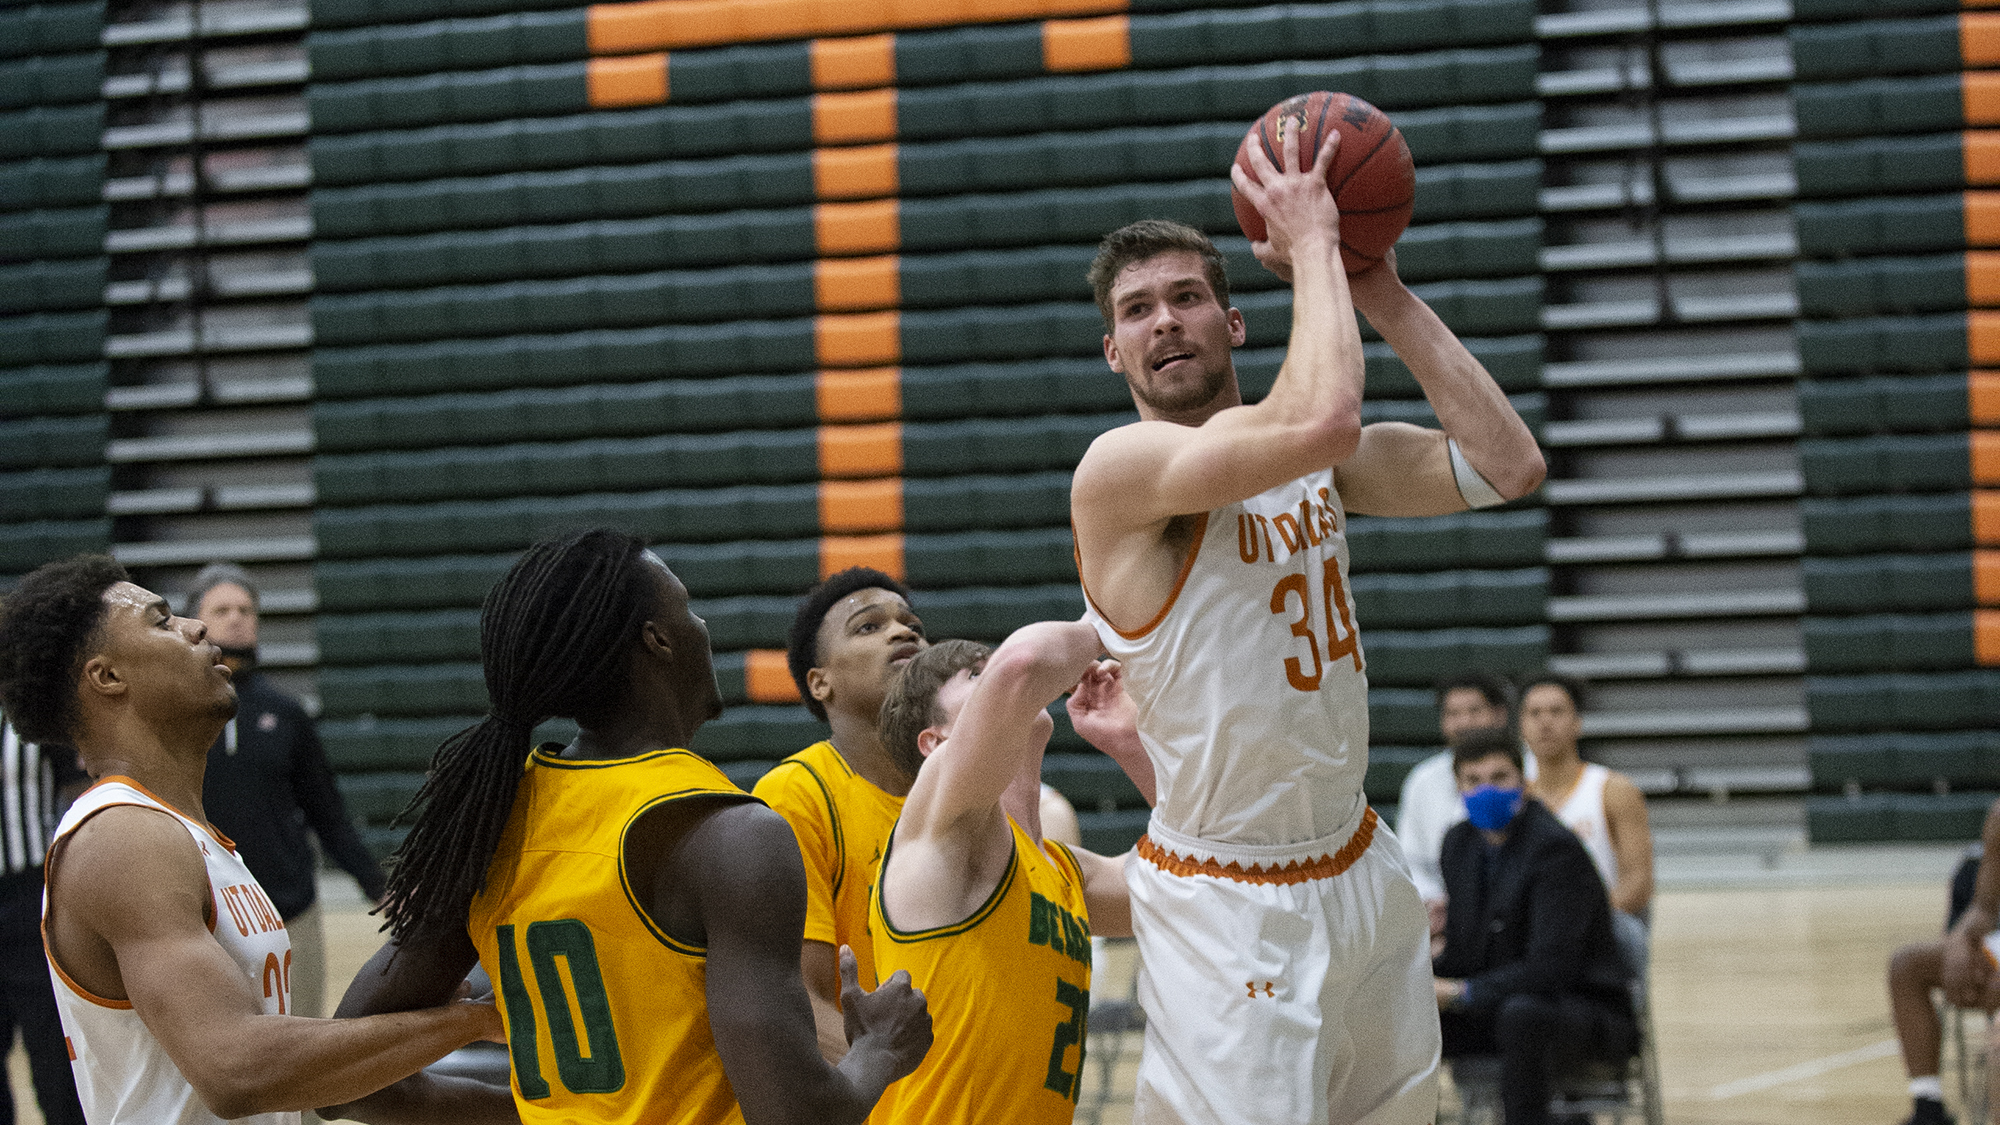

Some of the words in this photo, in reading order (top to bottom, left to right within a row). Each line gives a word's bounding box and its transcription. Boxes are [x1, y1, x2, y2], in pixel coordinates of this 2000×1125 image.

[1238, 512, 1275, 564] UT
[1269, 556, 1364, 692] 34
[220, 885, 258, 937] UT
[496, 918, 626, 1101] 10
